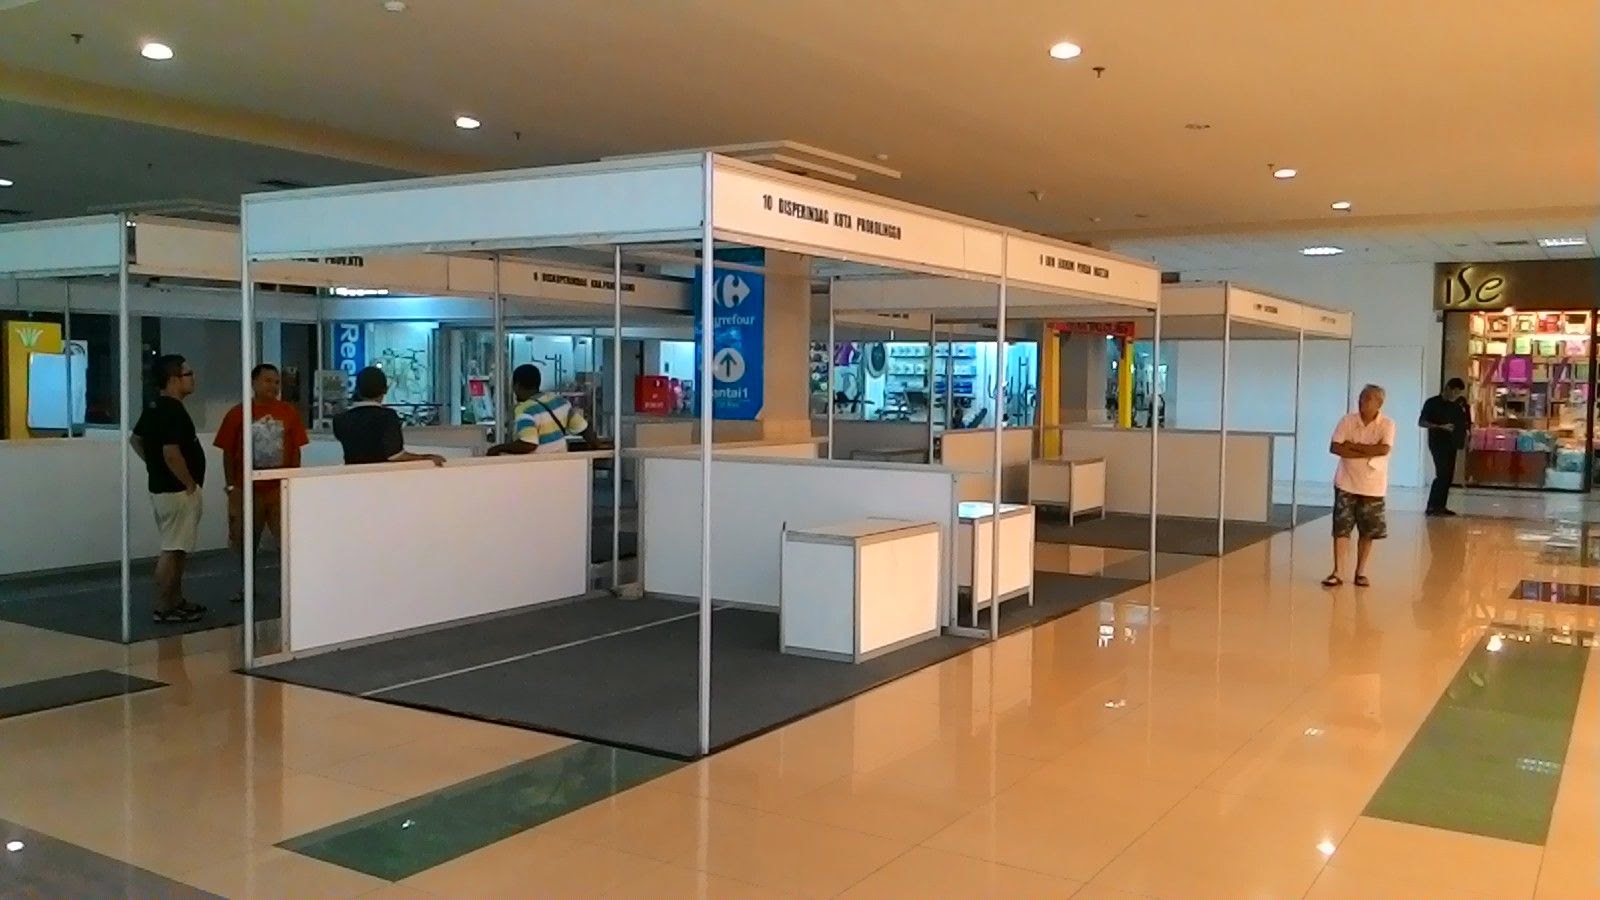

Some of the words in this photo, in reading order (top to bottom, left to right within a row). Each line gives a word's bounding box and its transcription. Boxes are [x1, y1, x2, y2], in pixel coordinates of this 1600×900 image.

[762, 193, 773, 211] 10
[778, 197, 829, 225] DISPERINDAG
[833, 212, 852, 230] KOTA
[713, 387, 742, 399] antai
